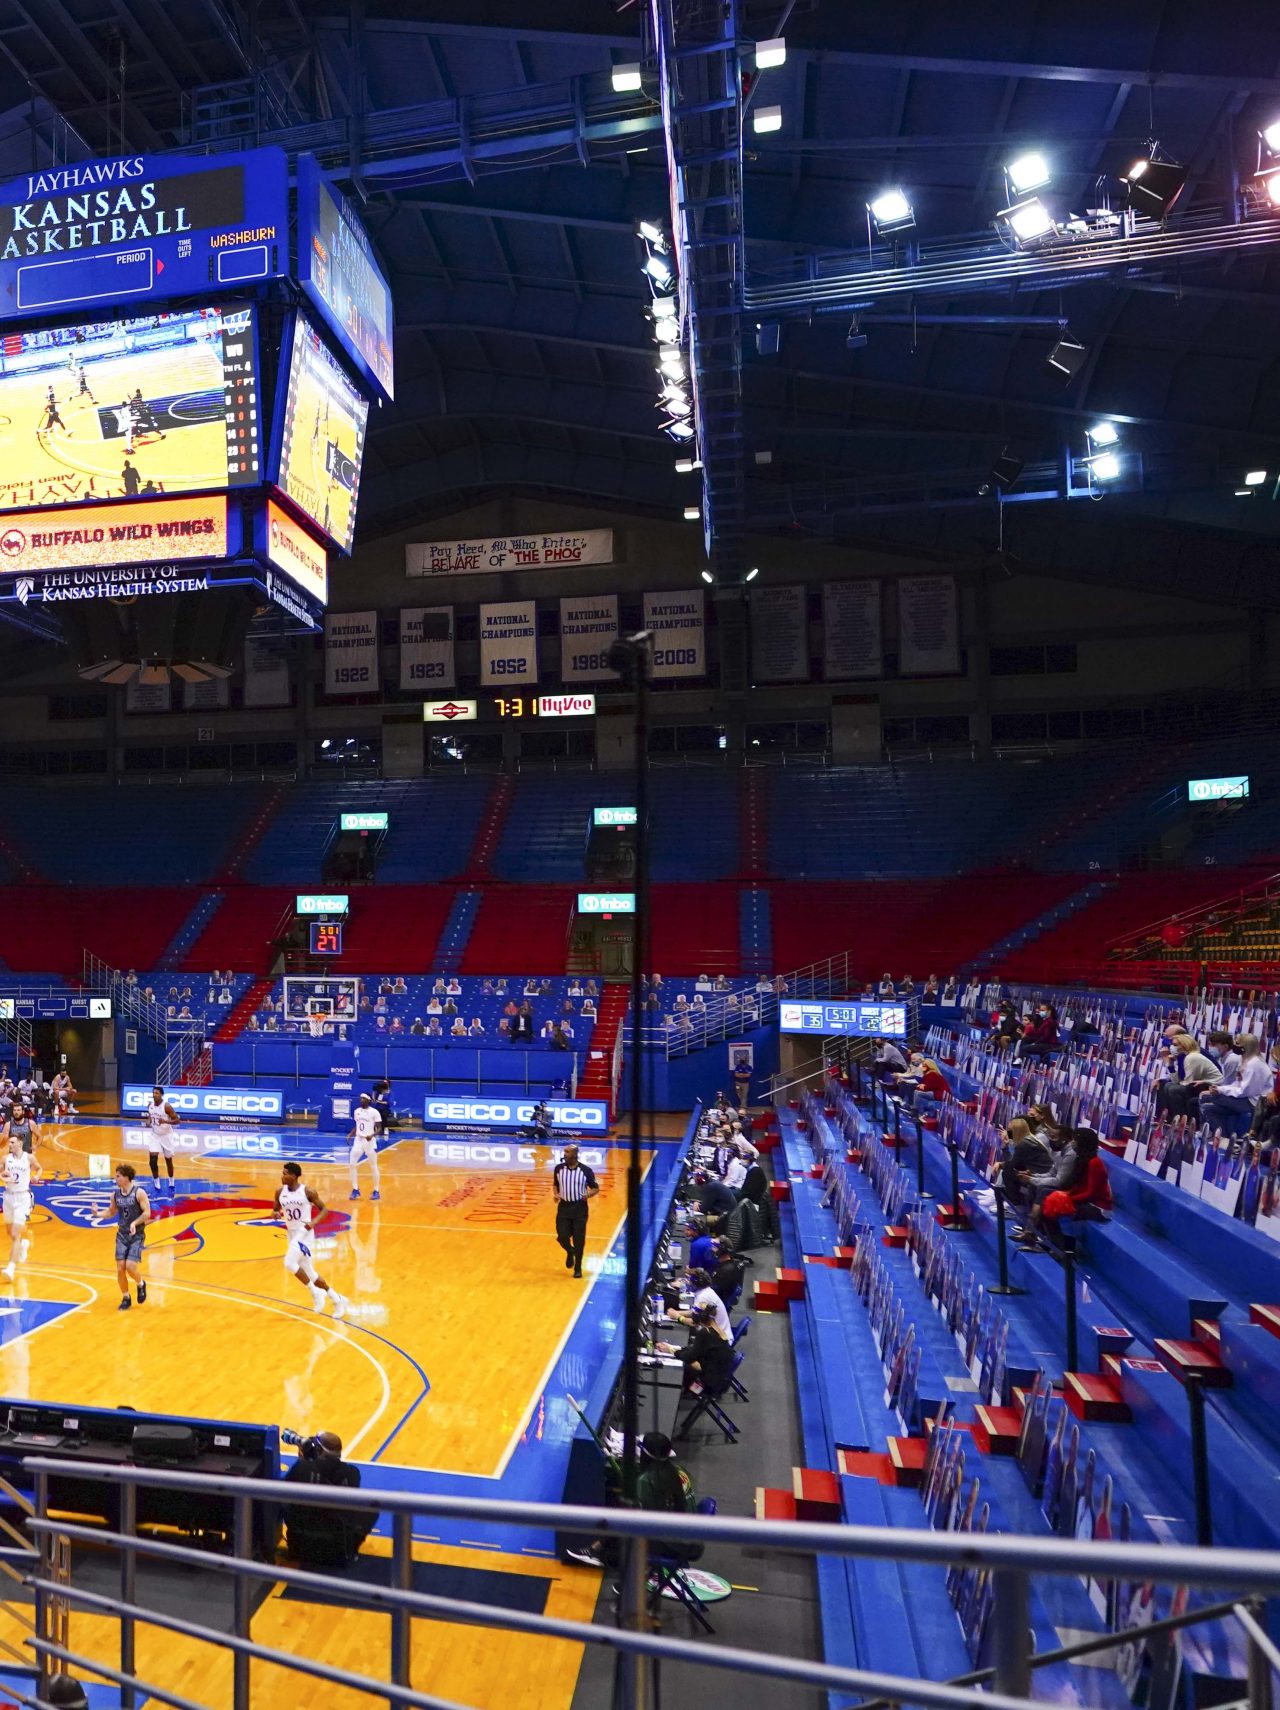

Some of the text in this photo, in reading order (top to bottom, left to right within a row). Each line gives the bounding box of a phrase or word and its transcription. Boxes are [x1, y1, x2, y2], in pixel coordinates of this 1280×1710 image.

[27, 157, 145, 200] JAYHAWKS
[12, 183, 156, 232] KANSAS
[210, 226, 276, 248] WASHBURN
[116, 252, 146, 264] PERIOD
[178, 250, 191, 258] LEFT
[31, 518, 215, 548] BUFFALO WILD WINGS
[430, 546, 451, 557] Pay
[457, 543, 487, 556] Heed,
[491, 541, 507, 552] All
[511, 539, 536, 550] Who
[431, 555, 480, 573] BEWARE
[489, 554, 507, 567] OF
[42, 565, 179, 587] THE UNIVERSITY OF
[42, 577, 208, 602] KANSAS HEALTH SYSTEM
[567, 609, 612, 621] NATIONAL
[651, 604, 697, 616] NATIONAL
[486, 614, 530, 626] NATIONAL
[562, 622, 617, 634] CHAMPIONS
[646, 618, 702, 630] CHAMPIONS
[332, 624, 372, 635] NATIONAL
[481, 628, 534, 639] CHAMPIONS
[327, 637, 376, 649] CHAMPIONS
[572, 654, 609, 670] 1988
[654, 648, 696, 666] 2008
[409, 663, 445, 679] 1923
[490, 658, 527, 675] 1952
[334, 667, 369, 683] 1922
[495, 699, 537, 717] 7:31
[317, 937, 336, 951] 27
[204, 1095, 279, 1112] GEICO
[428, 1102, 602, 1125] GEICO GICO
[286, 1208, 301, 1221] 30
